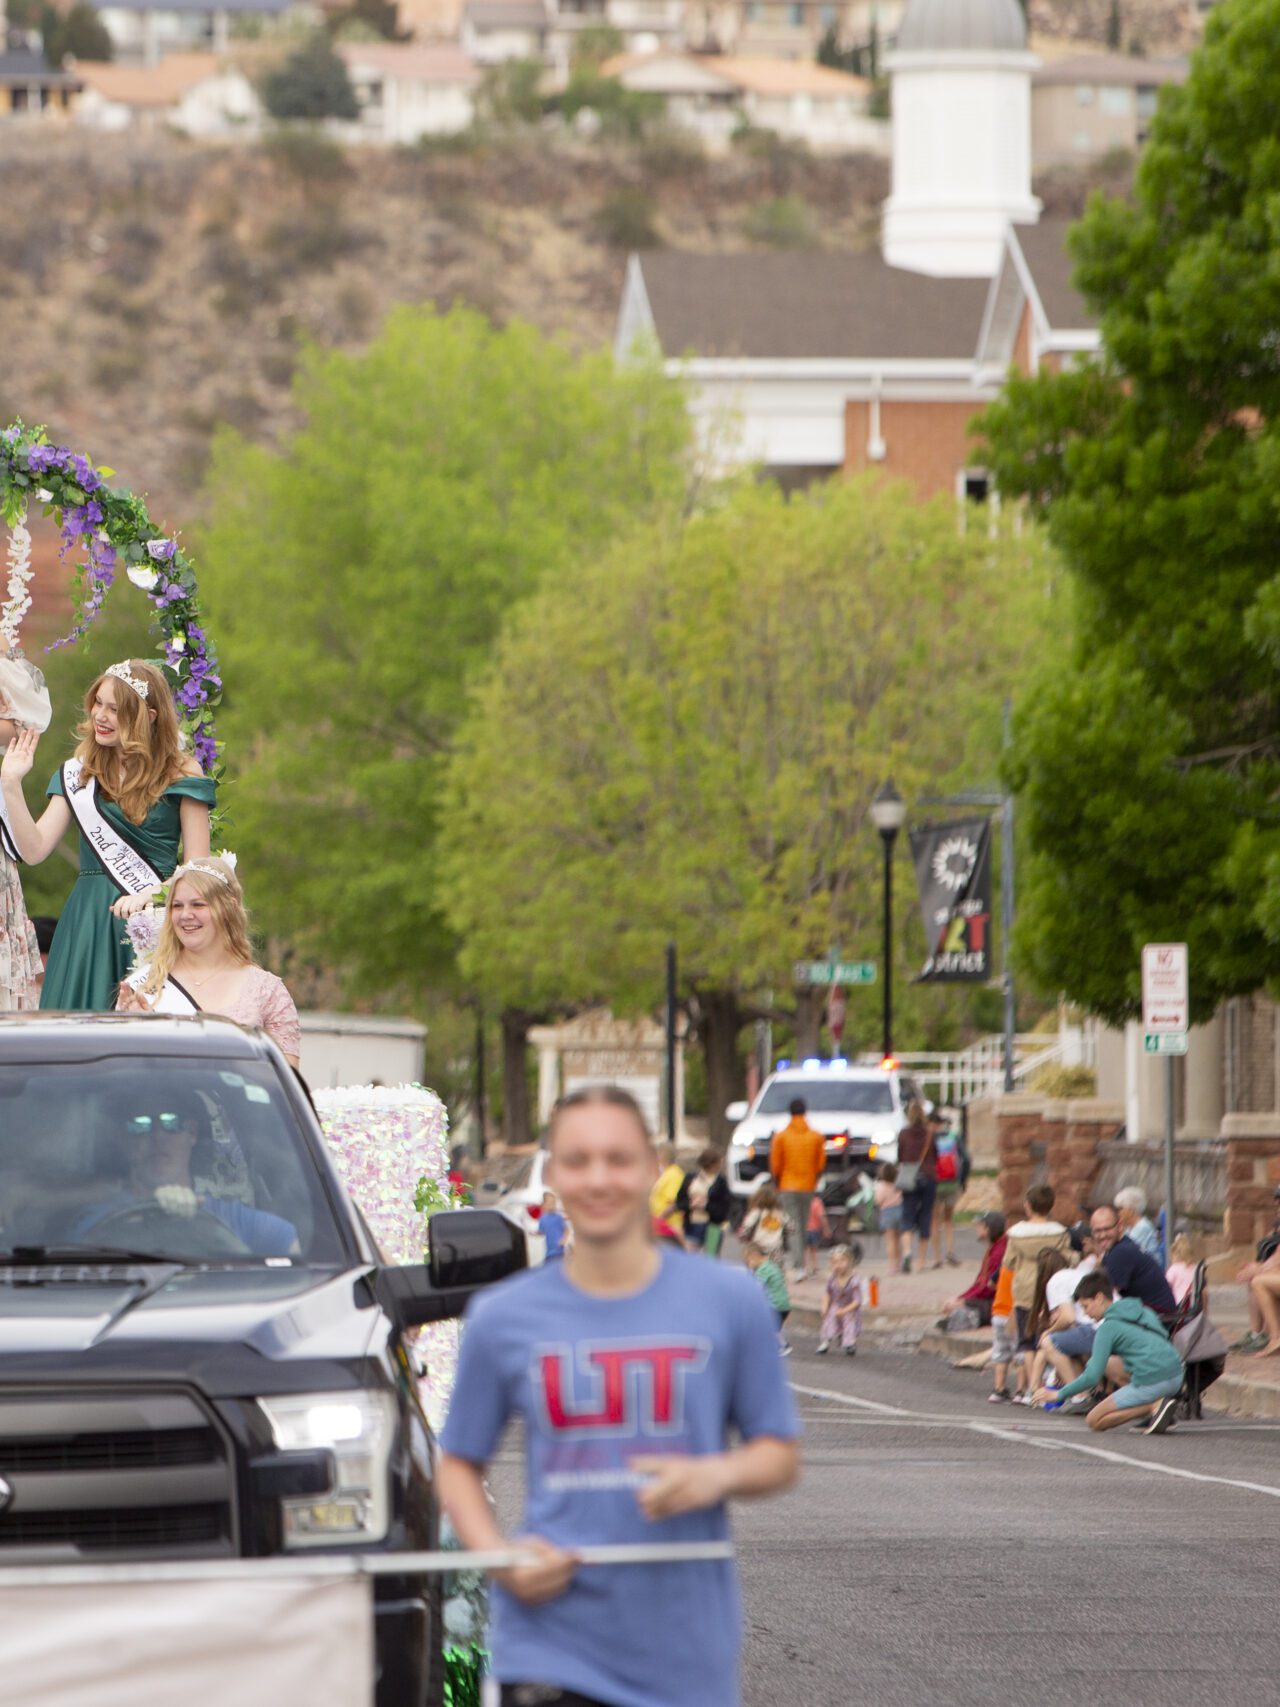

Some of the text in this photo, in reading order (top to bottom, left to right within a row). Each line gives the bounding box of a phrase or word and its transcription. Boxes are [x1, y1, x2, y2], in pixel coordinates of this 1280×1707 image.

[66, 770, 80, 781] 20
[90, 826, 154, 893] 2nd Attend
